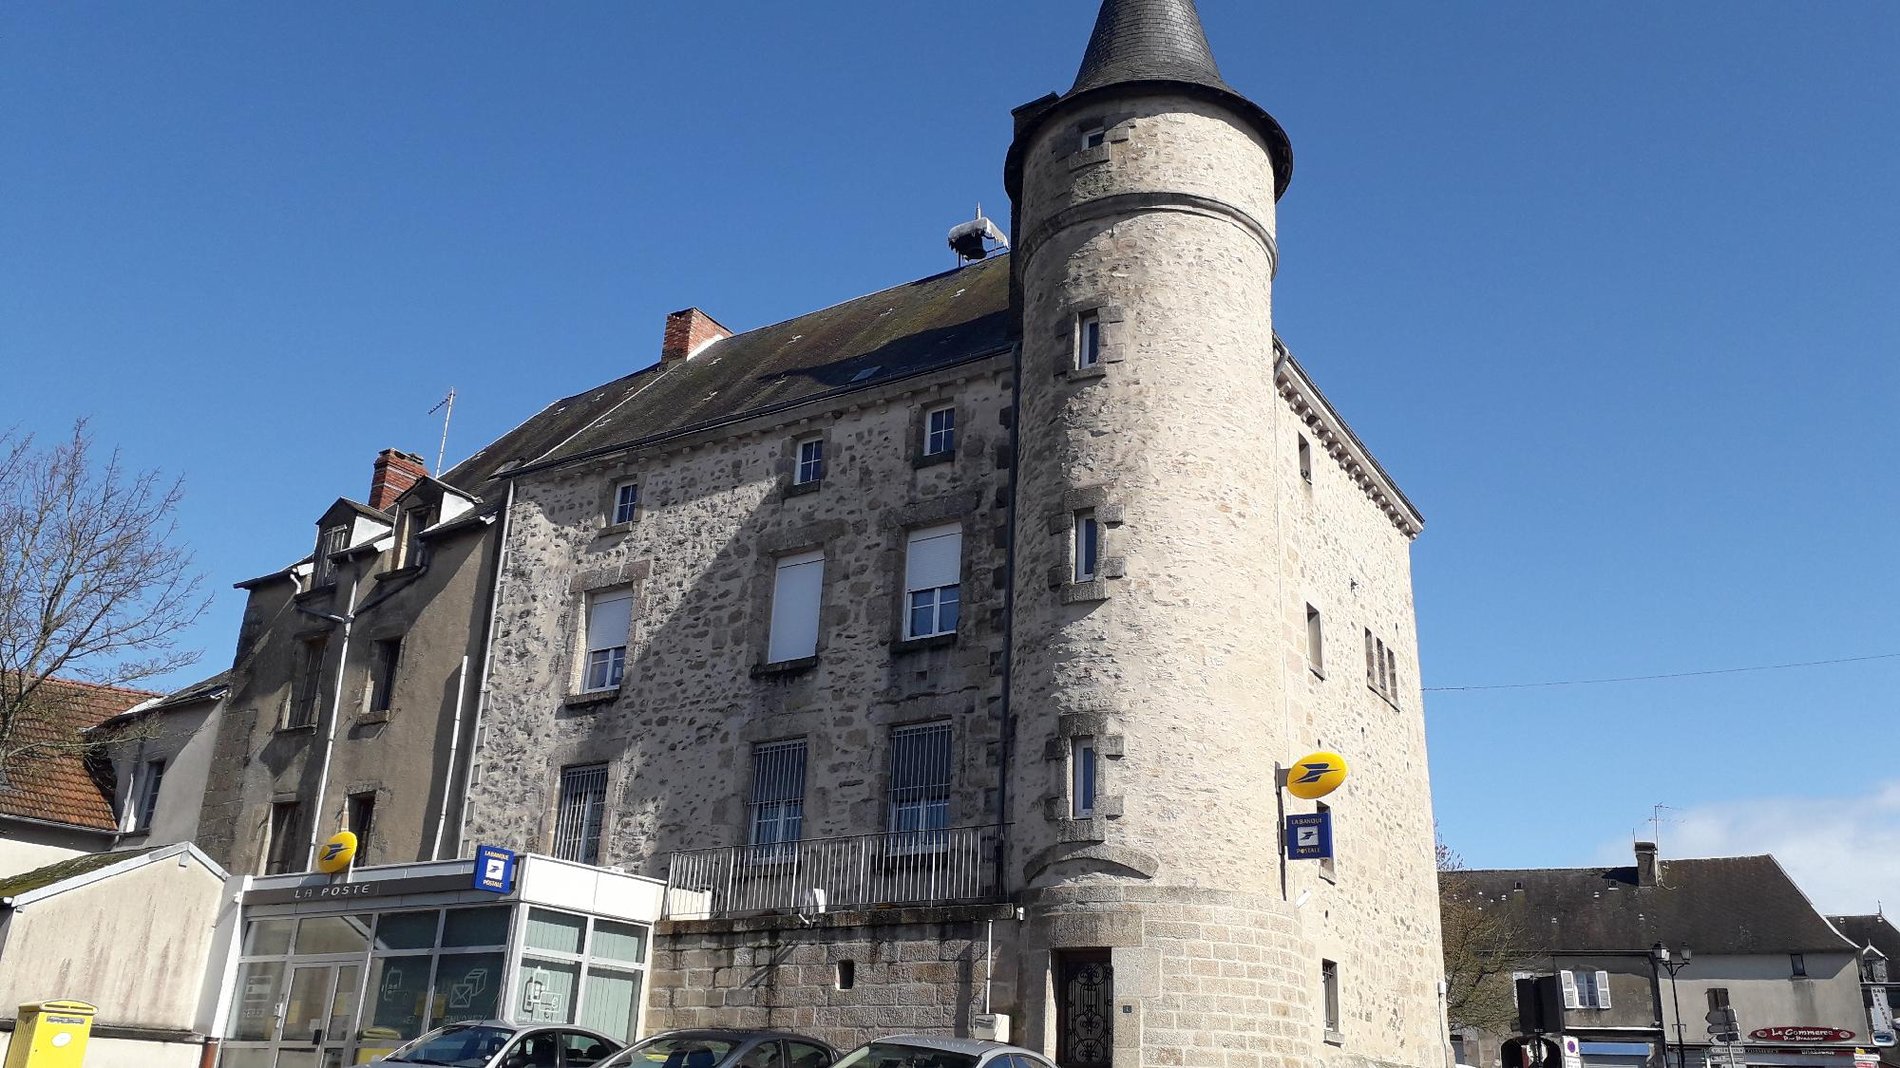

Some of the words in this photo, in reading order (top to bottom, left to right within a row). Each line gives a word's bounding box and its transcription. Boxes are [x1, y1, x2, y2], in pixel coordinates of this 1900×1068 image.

[294, 888, 313, 899] LA
[321, 884, 370, 897] POSTE
[1771, 1028, 1783, 1037] Le
[1785, 1028, 1834, 1037] Commerce
